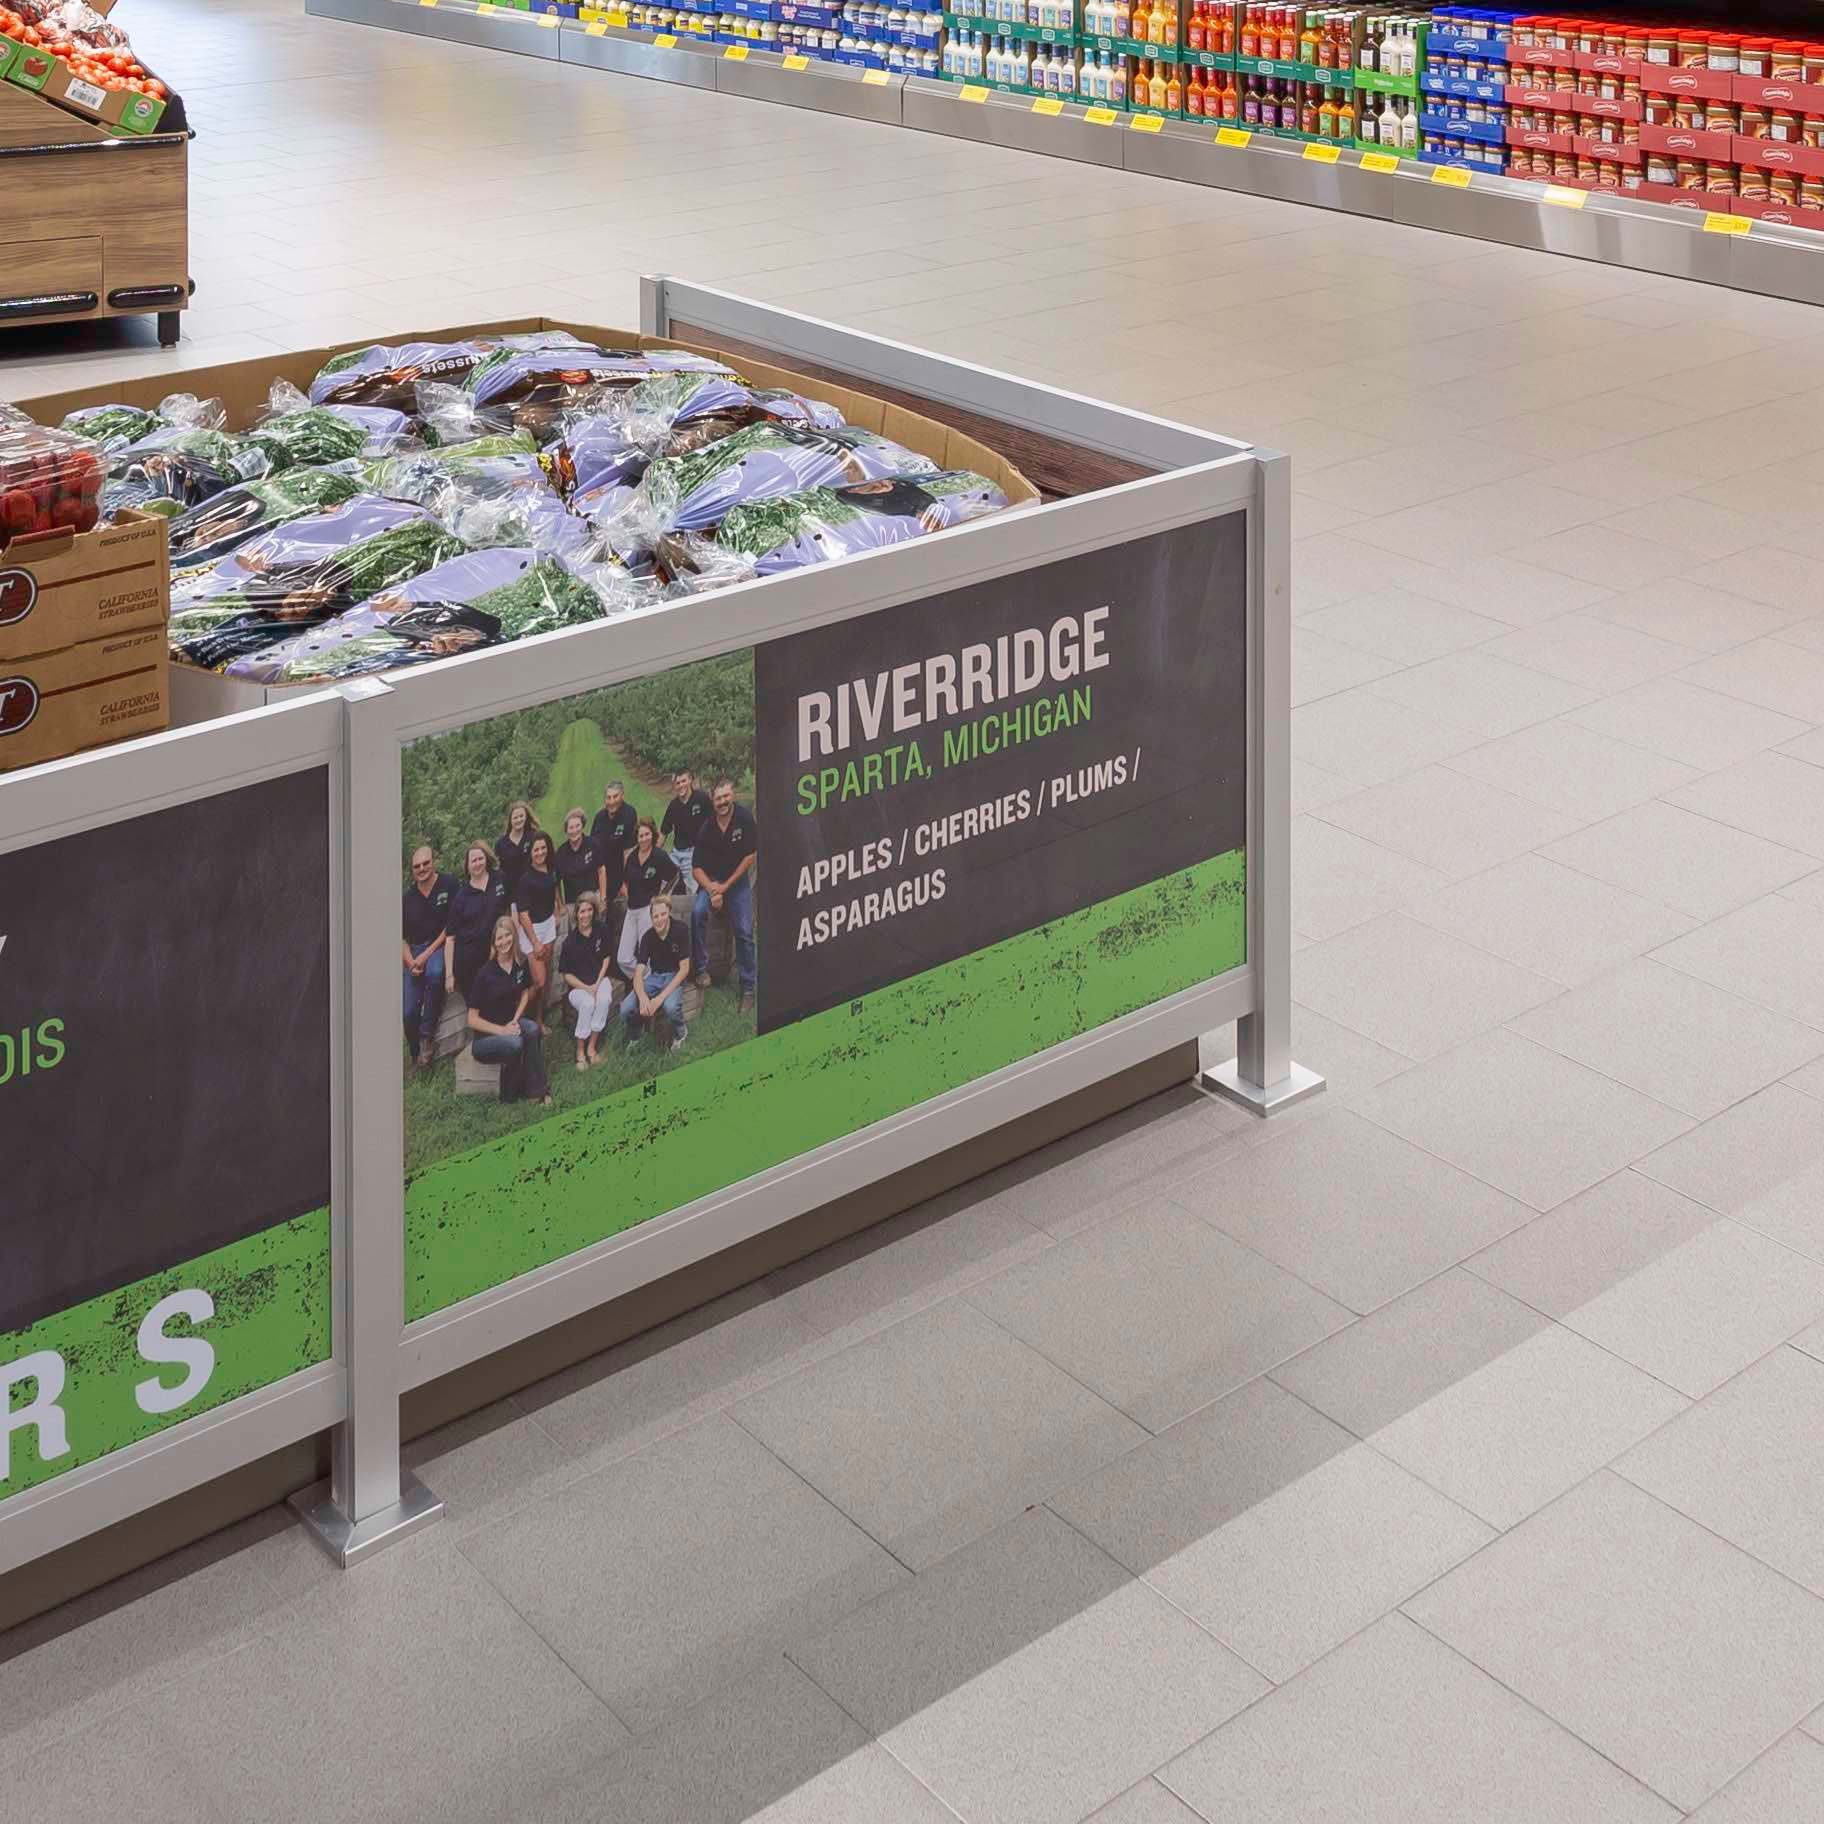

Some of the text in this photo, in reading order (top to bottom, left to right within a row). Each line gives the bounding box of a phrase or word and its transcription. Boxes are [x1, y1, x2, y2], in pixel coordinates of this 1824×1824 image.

[98, 587, 159, 610] CALIFORNIA
[100, 691, 161, 715] CALIFORNIA
[797, 605, 1111, 763] RIVERRIDGE
[797, 685, 1094, 817] SPARTA, MICHIGAN
[797, 757, 1128, 900] APPLES CHERRIES PLUMS
[796, 868, 948, 952] ASPARAGUS
